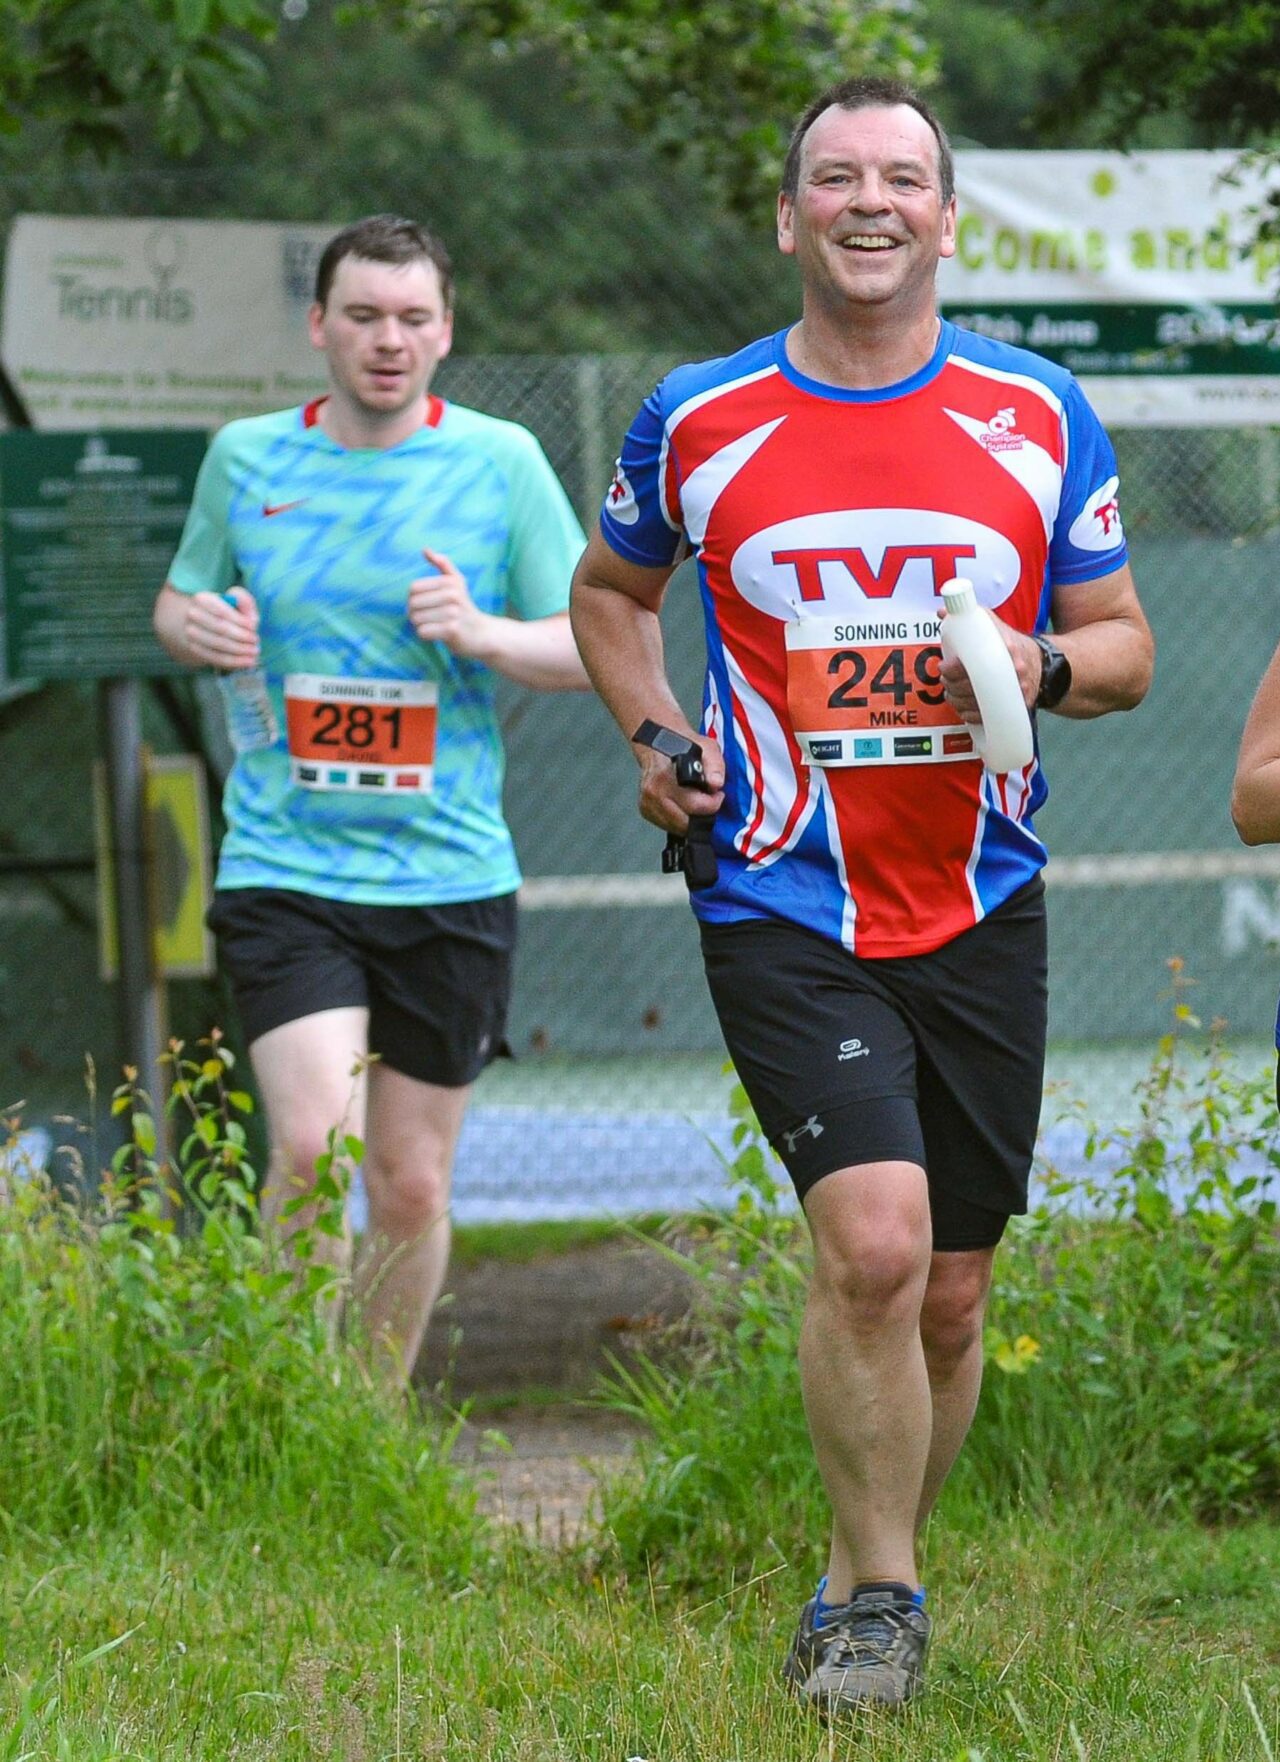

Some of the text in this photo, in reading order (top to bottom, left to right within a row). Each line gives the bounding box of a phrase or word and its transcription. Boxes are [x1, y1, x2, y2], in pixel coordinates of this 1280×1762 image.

[956, 212, 1107, 273] Come
[1129, 213, 1231, 273] and
[53, 272, 195, 324] Tennis
[771, 543, 977, 602] TVT
[833, 621, 942, 642] SONNING 10K
[826, 646, 947, 709] 249
[311, 702, 401, 749] 281
[869, 709, 919, 727] MIKE
